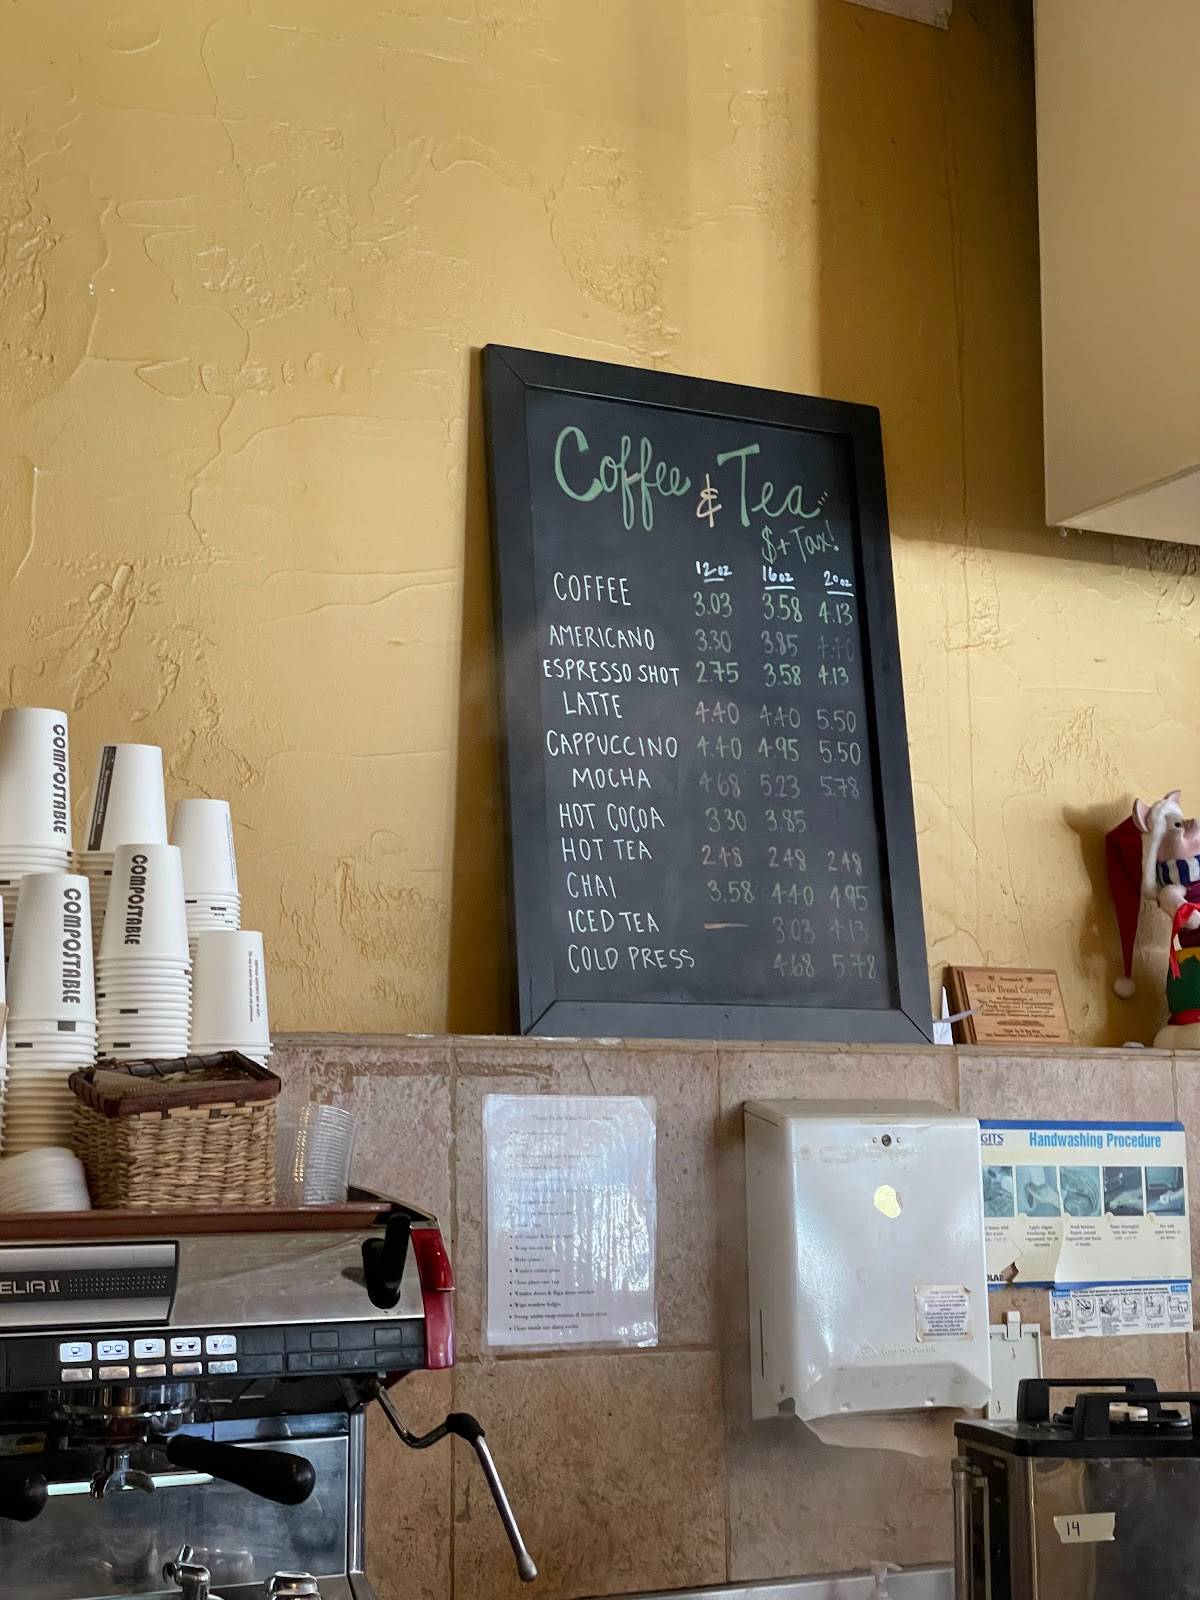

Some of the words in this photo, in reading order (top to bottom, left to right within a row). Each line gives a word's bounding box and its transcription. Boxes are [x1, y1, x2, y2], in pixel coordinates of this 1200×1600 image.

[555, 426, 691, 531] Coffee
[696, 473, 722, 528] &
[716, 444, 820, 528] Tea
[554, 572, 631, 606] COFFEE
[693, 591, 732, 617] 3.03
[762, 593, 802, 622] 3.58
[819, 601, 853, 625] 4.13
[550, 625, 654, 650] AMERICANO
[695, 629, 731, 653] 3.30
[761, 630, 798, 657] 3.85
[543, 658, 631, 683] ESPRESSO
[638, 665, 679, 686] SHOT
[696, 661, 739, 683] 2.75
[763, 663, 801, 687] 3.58
[819, 665, 849, 685] 4.13
[563, 691, 622, 718] LATTE
[695, 701, 739, 724] 4.40
[760, 705, 800, 728] 4.40
[817, 709, 856, 733] 5.50
[546, 730, 677, 758] CAPPUCCINO
[697, 736, 742, 760] 4.40
[758, 737, 799, 761] 4.95
[820, 740, 861, 765] 5.50
[52, 723, 67, 835] COMPOSTABLE
[573, 768, 651, 789] MOCHA
[760, 774, 800, 799] 5.23
[820, 775, 859, 799] 5.78
[559, 803, 595, 829] HOT
[607, 803, 665, 833] COCOA
[562, 837, 603, 862] HOT
[613, 839, 652, 860] TEA
[124, 854, 148, 946] COMPOSTABLE
[567, 872, 616, 898] CHAI
[707, 880, 755, 903] 3.58
[772, 883, 814, 906] 4.40
[568, 909, 614, 933] ICED
[619, 912, 659, 932] TEA
[62, 887, 82, 1005] COMPOSTABLE
[568, 944, 618, 973] COLD
[628, 946, 695, 970] PRESS
[1029, 1132, 1104, 1149] Handwashing
[1107, 1133, 1161, 1148] Procedure
[1066, 1521, 1081, 1537] 14
